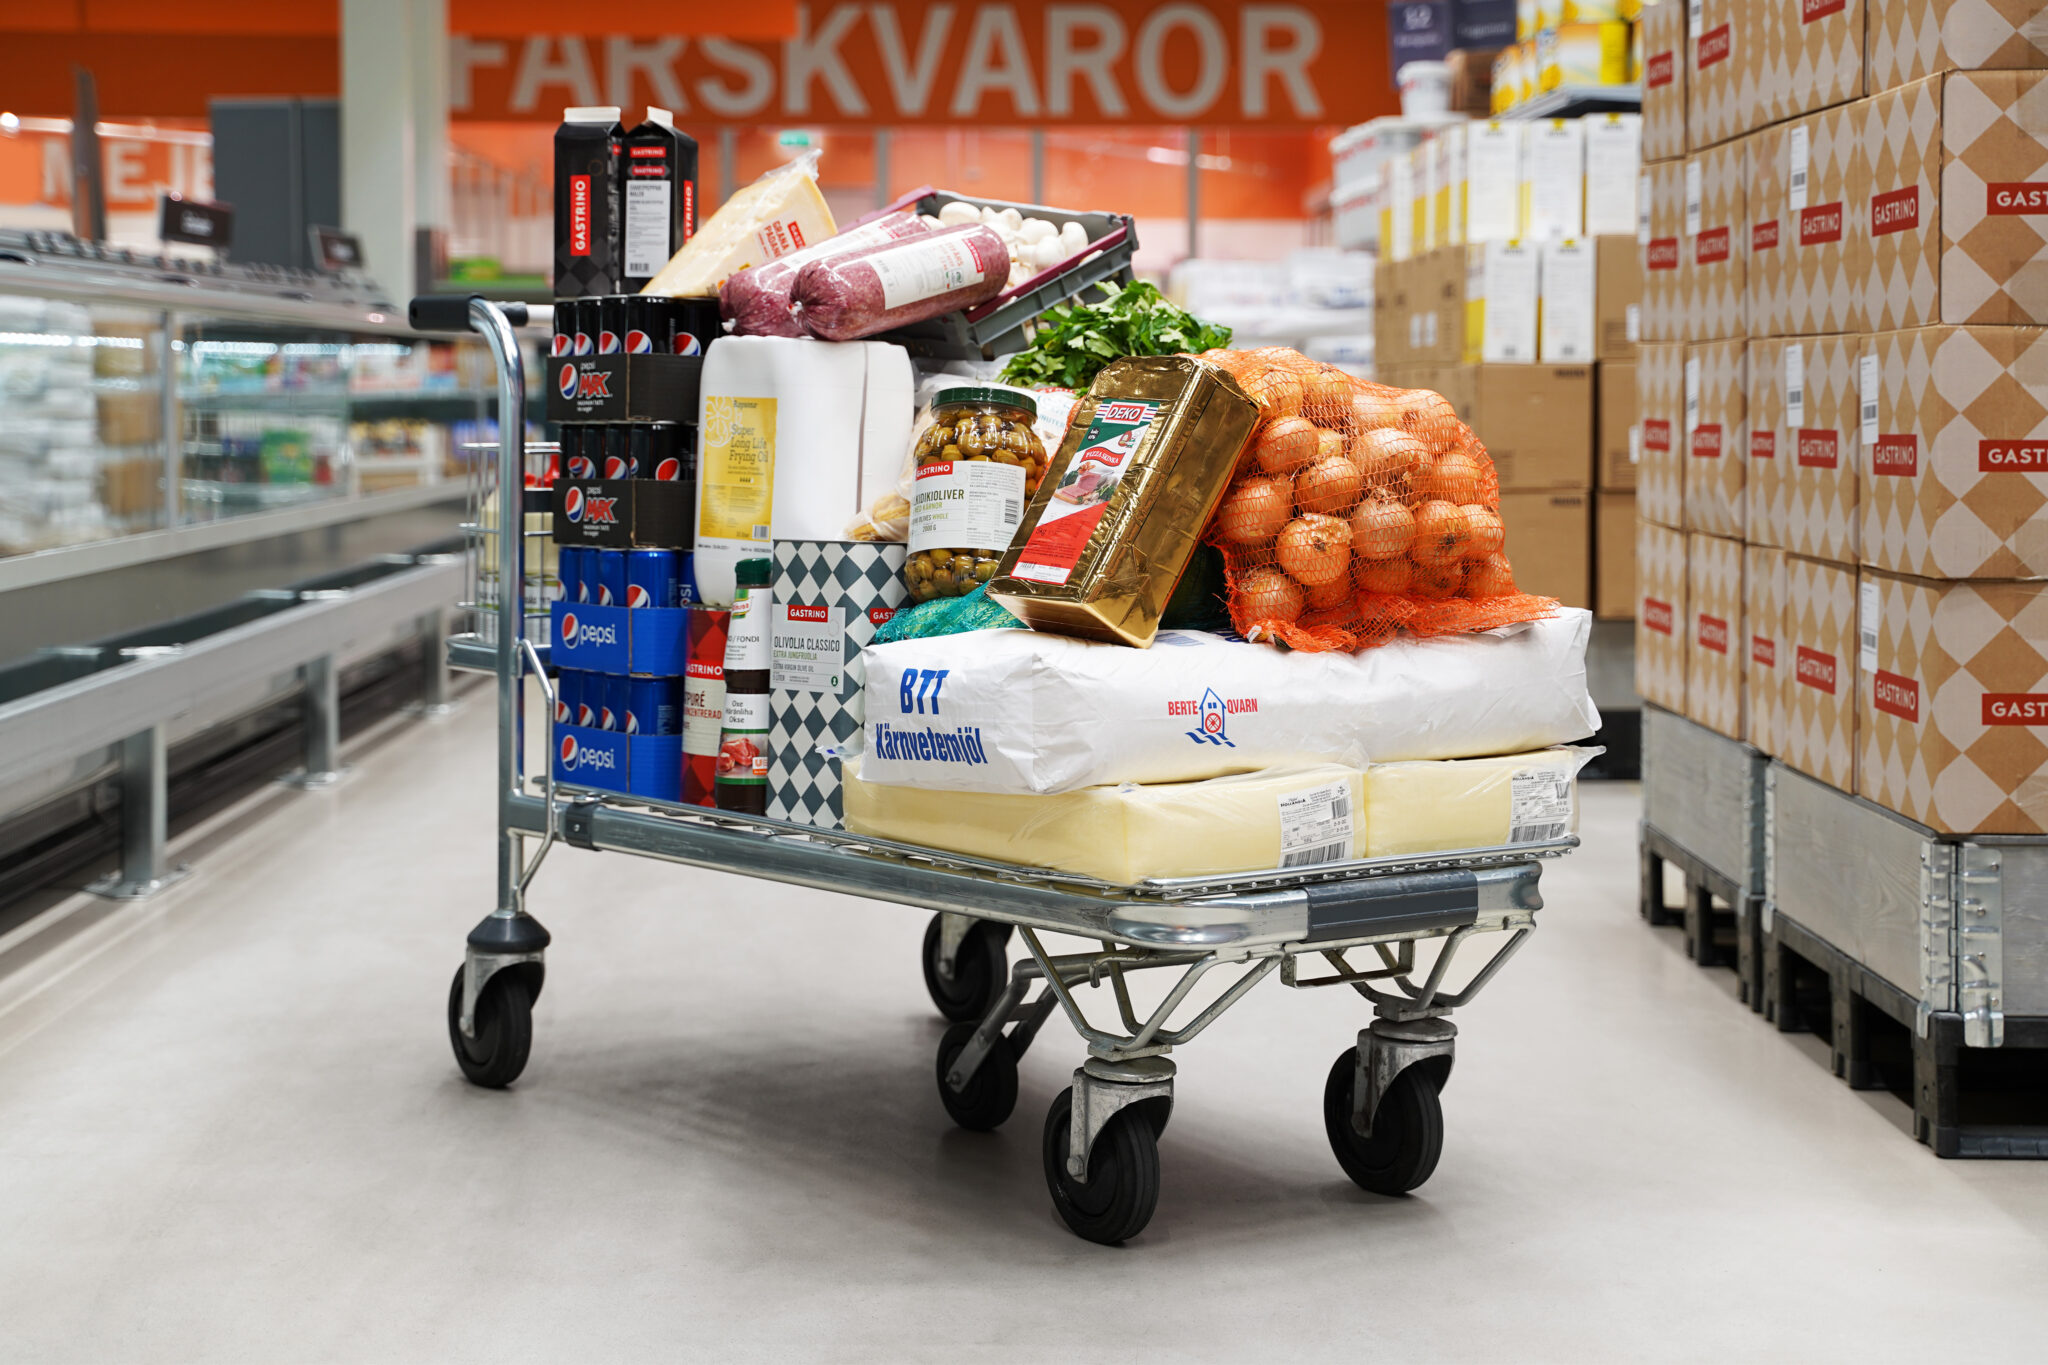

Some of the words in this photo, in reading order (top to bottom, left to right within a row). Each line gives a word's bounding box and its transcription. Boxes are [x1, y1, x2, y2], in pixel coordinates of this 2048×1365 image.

[575, 180, 586, 250] GASTRINO
[1874, 197, 1917, 225] GASTRINO
[1803, 212, 1839, 236] GASTRINO
[577, 371, 613, 399] MAX
[1107, 406, 1141, 420] DEKO
[731, 423, 755, 439] Super
[730, 437, 752, 452] Long
[1800, 439, 1835, 459] GASTRINO
[728, 449, 757, 465] Frying
[1875, 445, 1915, 465] GASTRINO
[1988, 448, 2048, 464] GAST
[916, 464, 951, 478] GASTRINO
[789, 608, 826, 619] GASTRINO
[580, 624, 617, 648] pepsi
[773, 635, 805, 650] OLIVOLJA
[807, 638, 841, 653] CLASSICO
[1798, 654, 1834, 684] GASTRINO
[900, 668, 951, 715] BTT
[1876, 680, 1917, 711] GASTRINO
[1167, 700, 1199, 716] BERTE
[1226, 698, 1259, 715] QVARN
[875, 723, 989, 767] Kärnvetemjöl
[579, 748, 616, 771] pepsi
